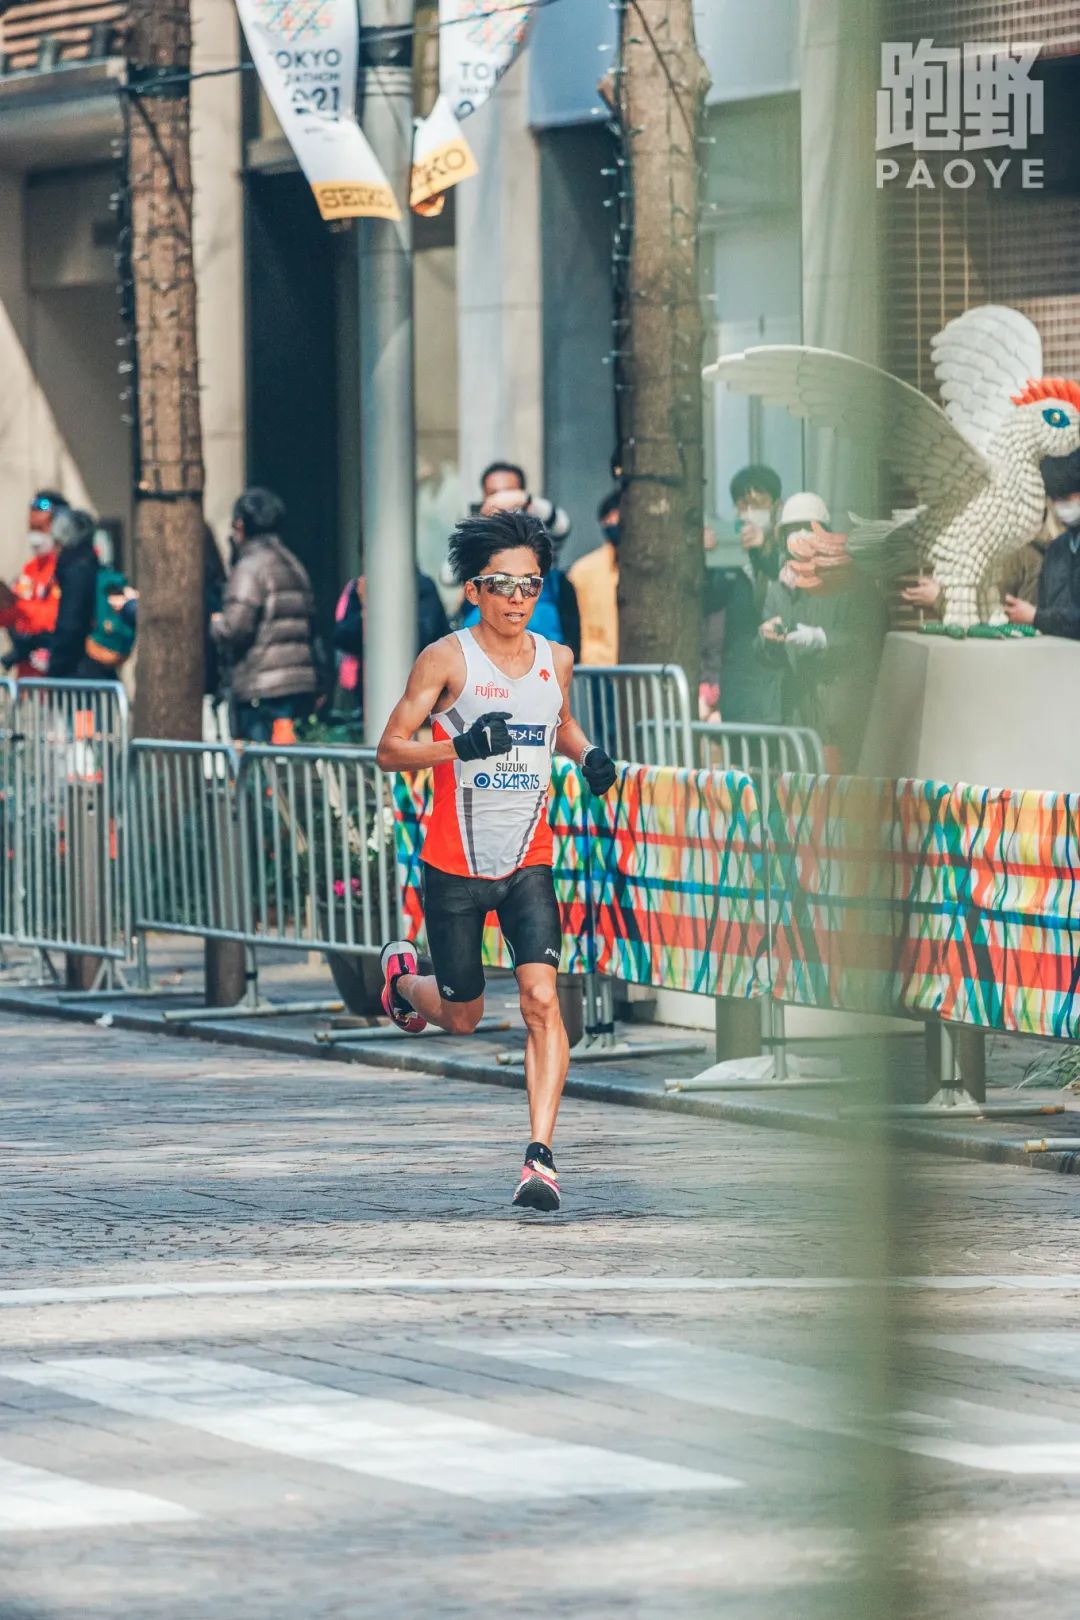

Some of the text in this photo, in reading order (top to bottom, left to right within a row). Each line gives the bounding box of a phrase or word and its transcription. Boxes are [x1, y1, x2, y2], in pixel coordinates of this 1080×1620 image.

[268, 48, 342, 69] OKYO
[475, 684, 509, 699] FUJITSU
[495, 762, 528, 773] SUZUKI
